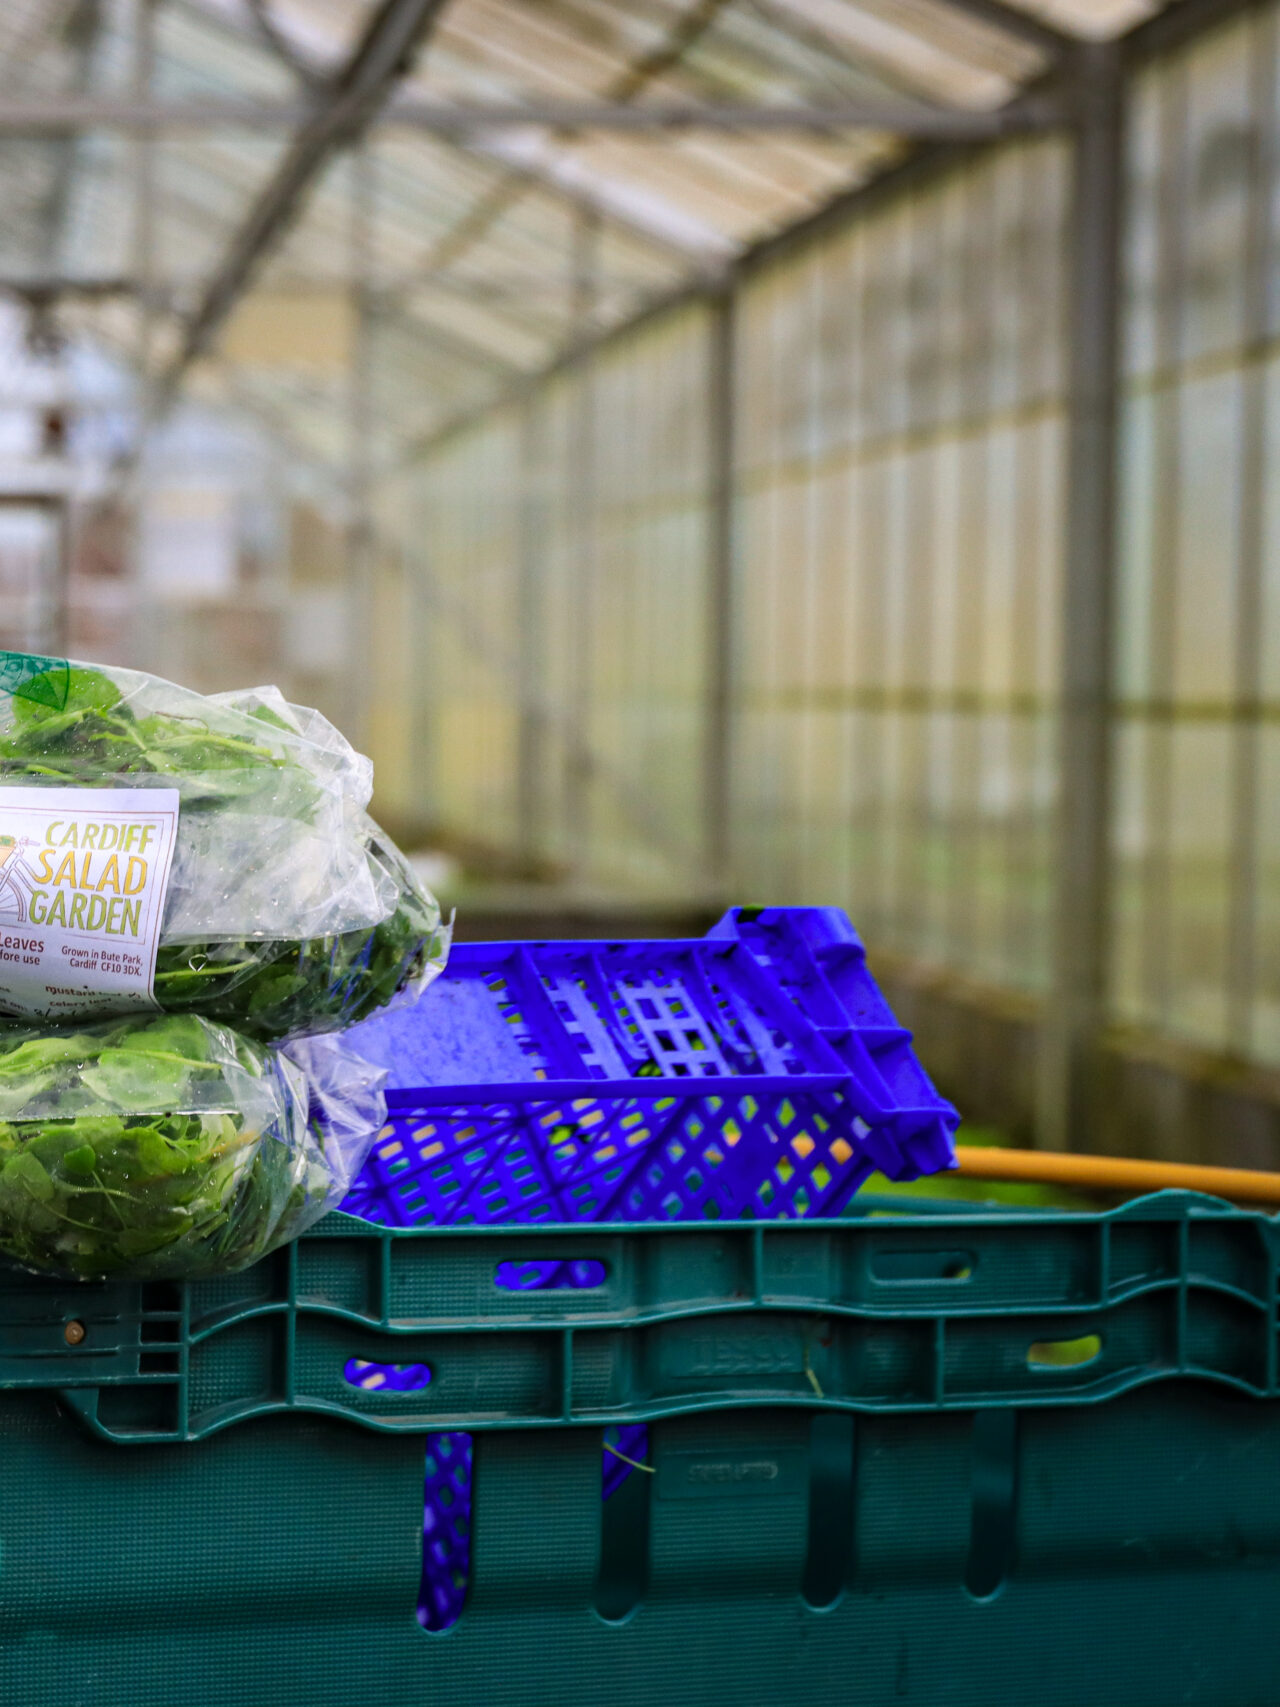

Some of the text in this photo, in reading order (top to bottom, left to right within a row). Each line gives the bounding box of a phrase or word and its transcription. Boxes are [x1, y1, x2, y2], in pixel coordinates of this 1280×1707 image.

[45, 821, 157, 854] CARDIFF
[38, 848, 148, 895] SALAD
[28, 889, 142, 937] GARDEN
[23, 954, 41, 966] use
[61, 945, 89, 958] Grown
[91, 949, 99, 959] in
[101, 951, 121, 961] Bute
[70, 958, 97, 970] Cardiff
[101, 962, 121, 973] CF10
